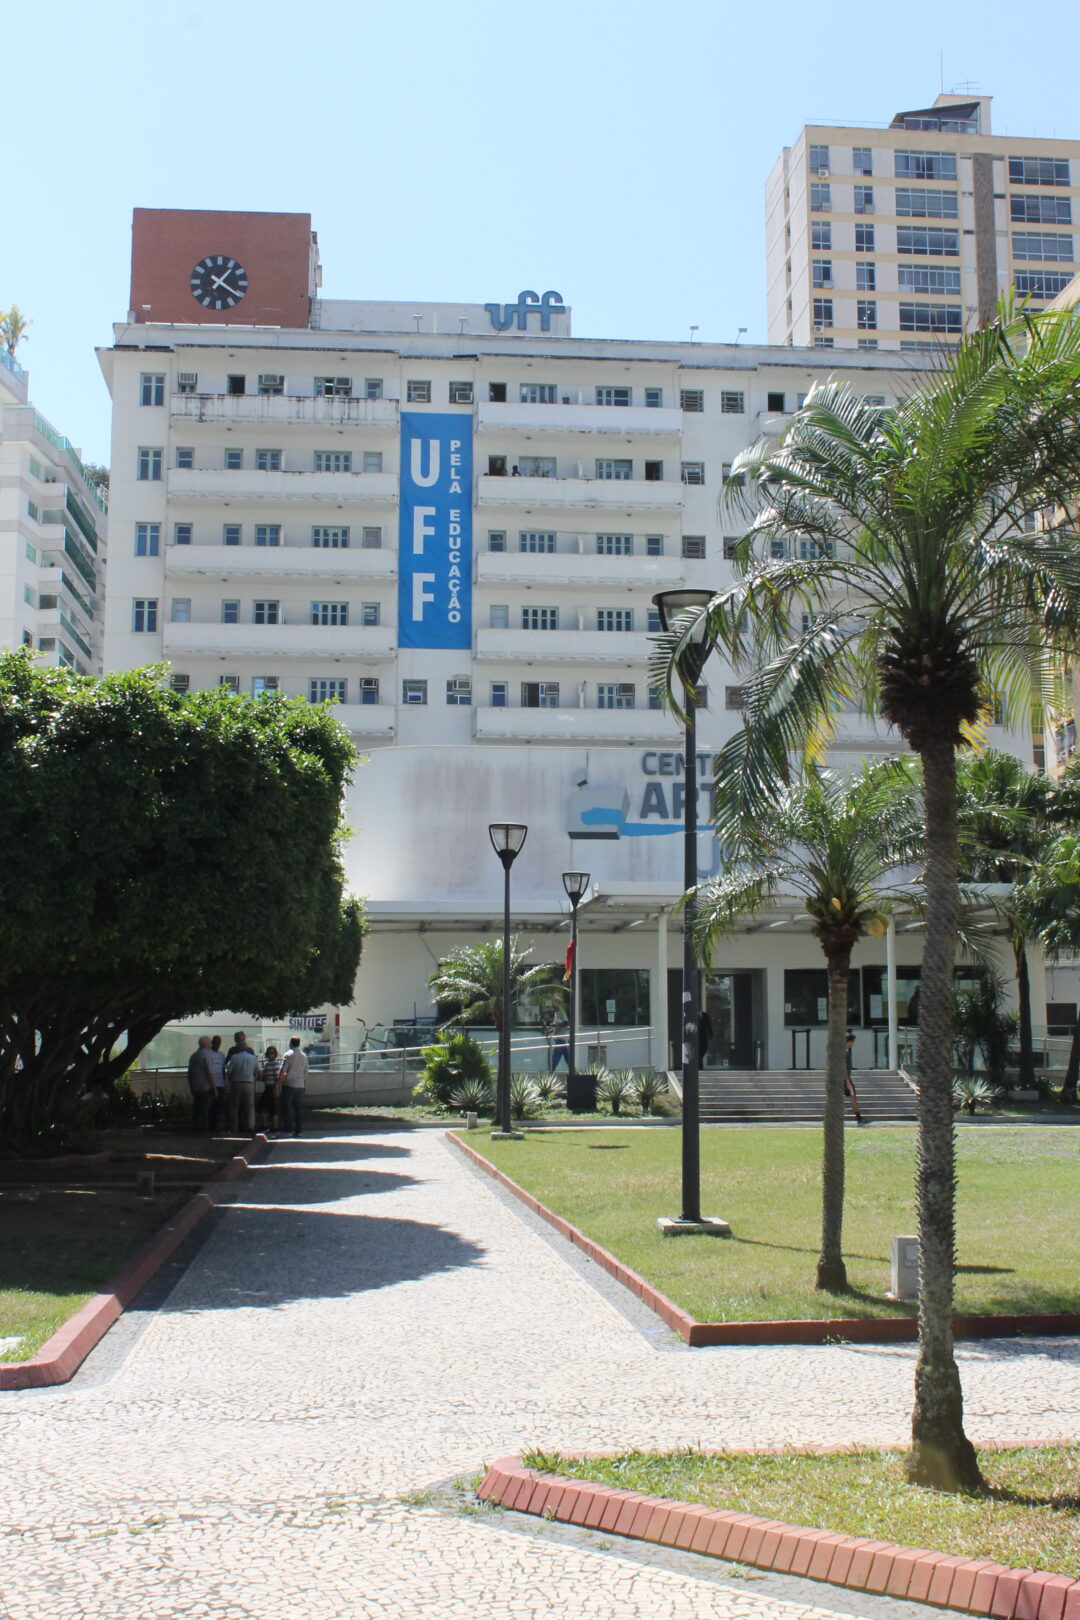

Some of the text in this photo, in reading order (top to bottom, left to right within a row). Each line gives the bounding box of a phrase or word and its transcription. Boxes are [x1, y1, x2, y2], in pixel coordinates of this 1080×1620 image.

[484, 290, 566, 331] uff
[411, 438, 441, 622] UFF
[448, 440, 462, 623] PELA EDUCAÇÃO
